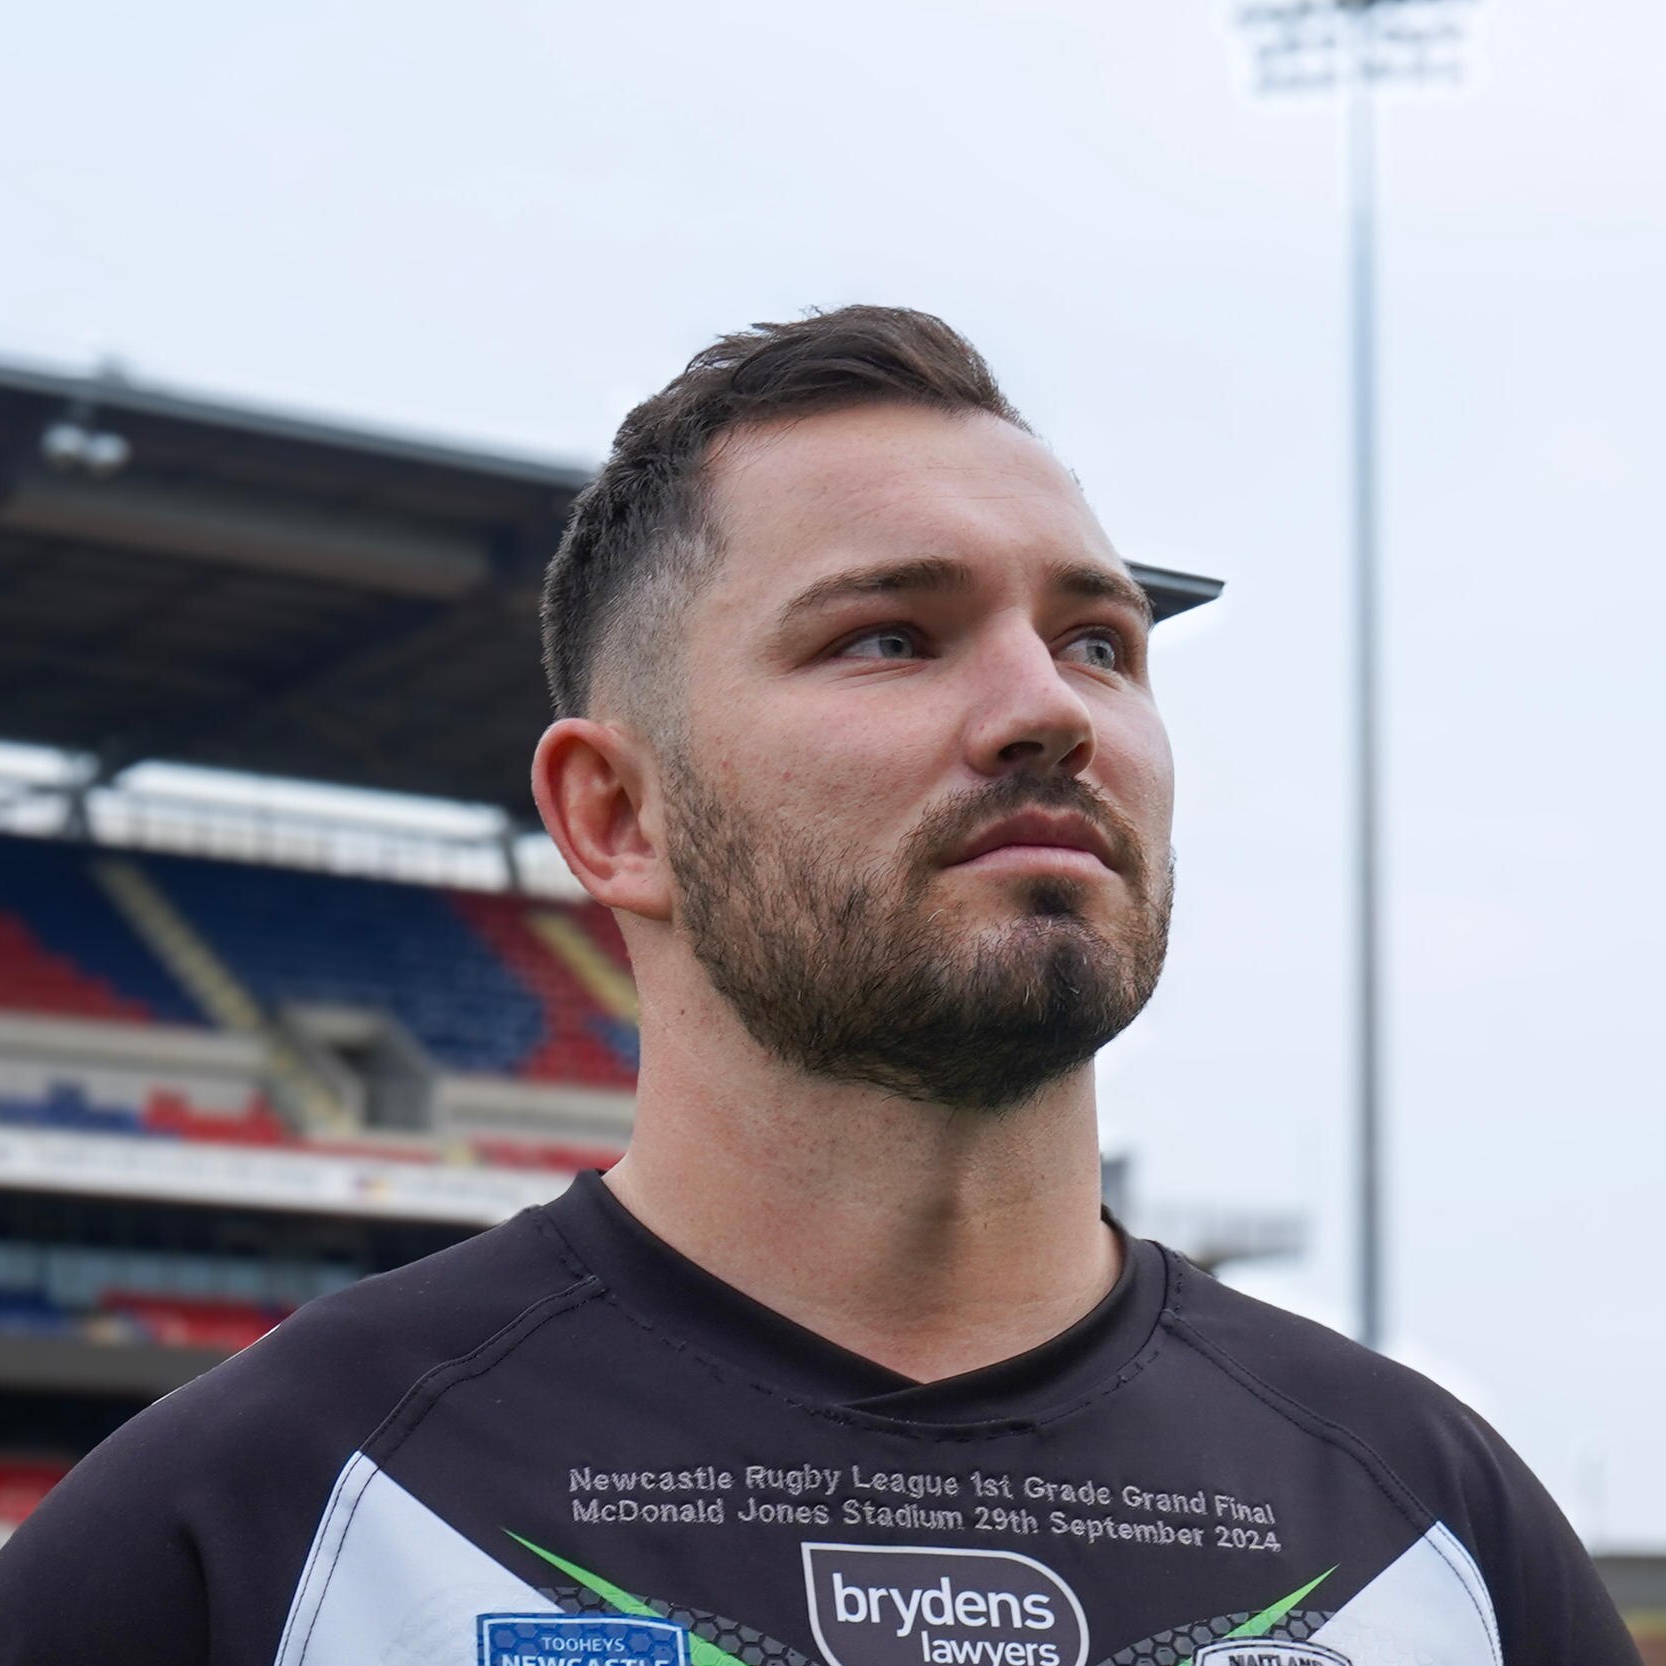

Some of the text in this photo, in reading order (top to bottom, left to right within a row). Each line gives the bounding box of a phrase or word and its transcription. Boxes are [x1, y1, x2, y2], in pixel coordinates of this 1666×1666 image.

[569, 1464, 1276, 1526] Newcastle Rugby League 1st Grade Grand Final
[572, 1497, 1282, 1552] McDonald Jones Stadium 29th September 2024
[832, 1573, 1055, 1637] brydens
[541, 1636, 626, 1652] TOOHEYS
